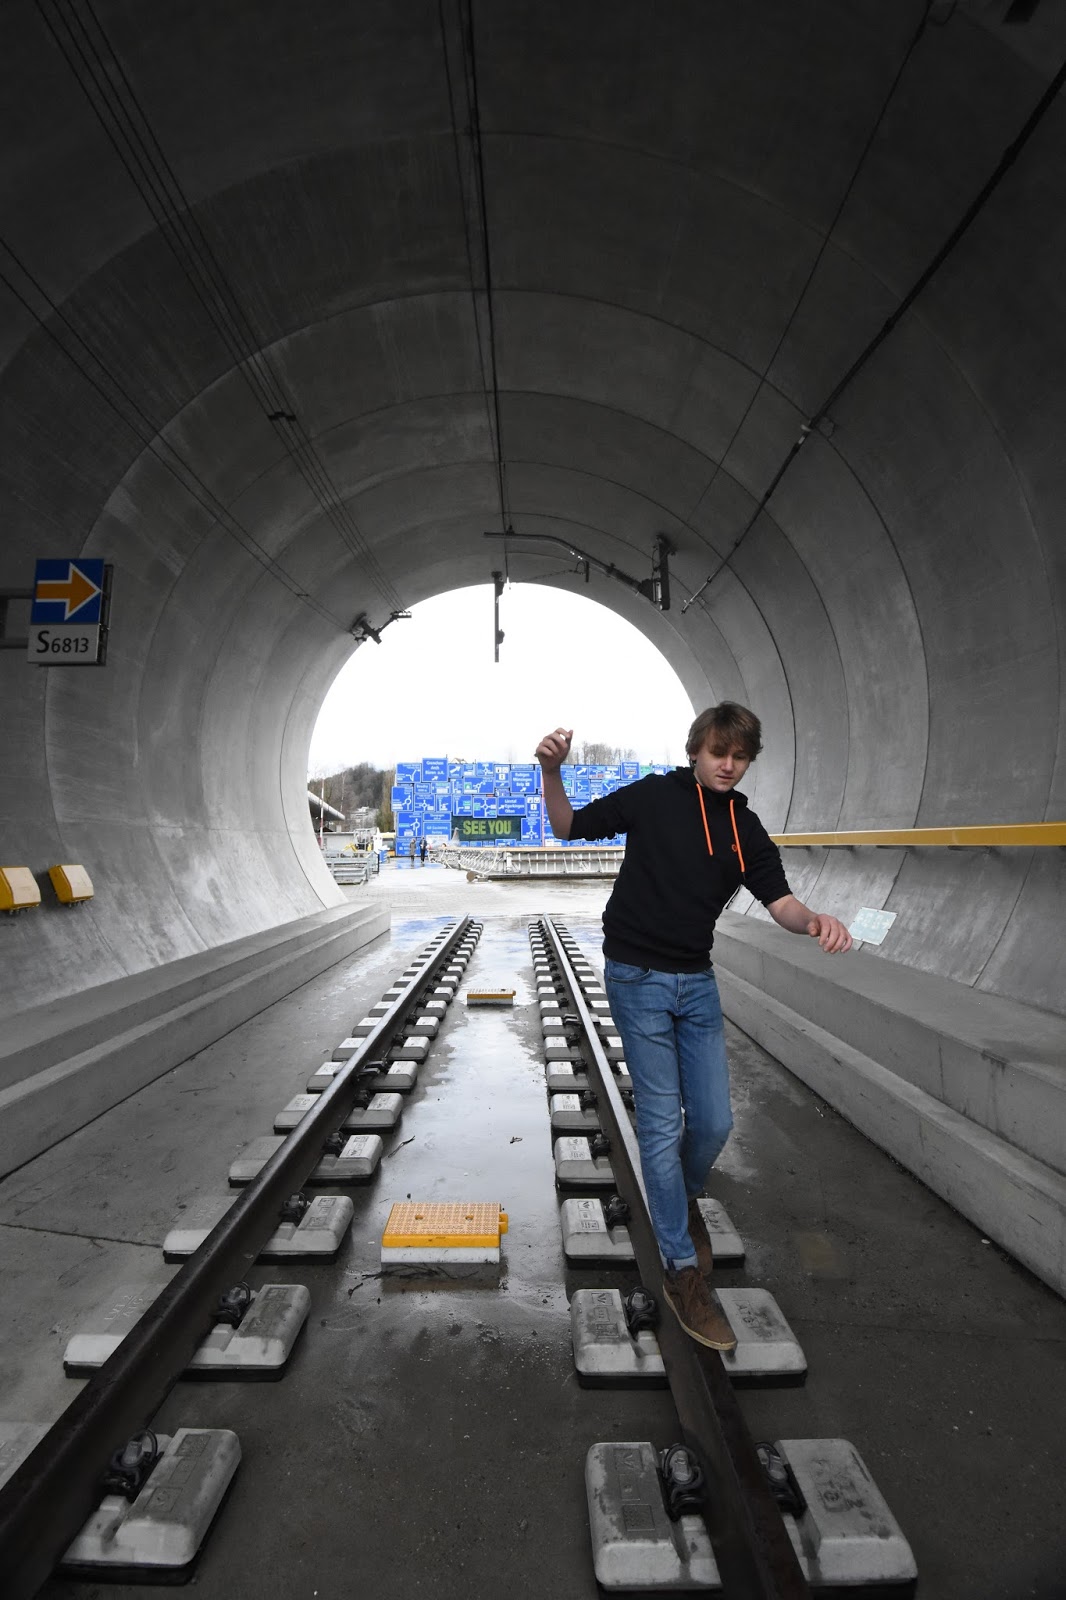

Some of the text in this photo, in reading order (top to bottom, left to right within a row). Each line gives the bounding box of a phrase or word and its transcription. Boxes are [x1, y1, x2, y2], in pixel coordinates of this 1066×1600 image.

[36, 630, 90, 654] S6813
[462, 820, 487, 835] SEE
[488, 820, 512, 835] YOU
